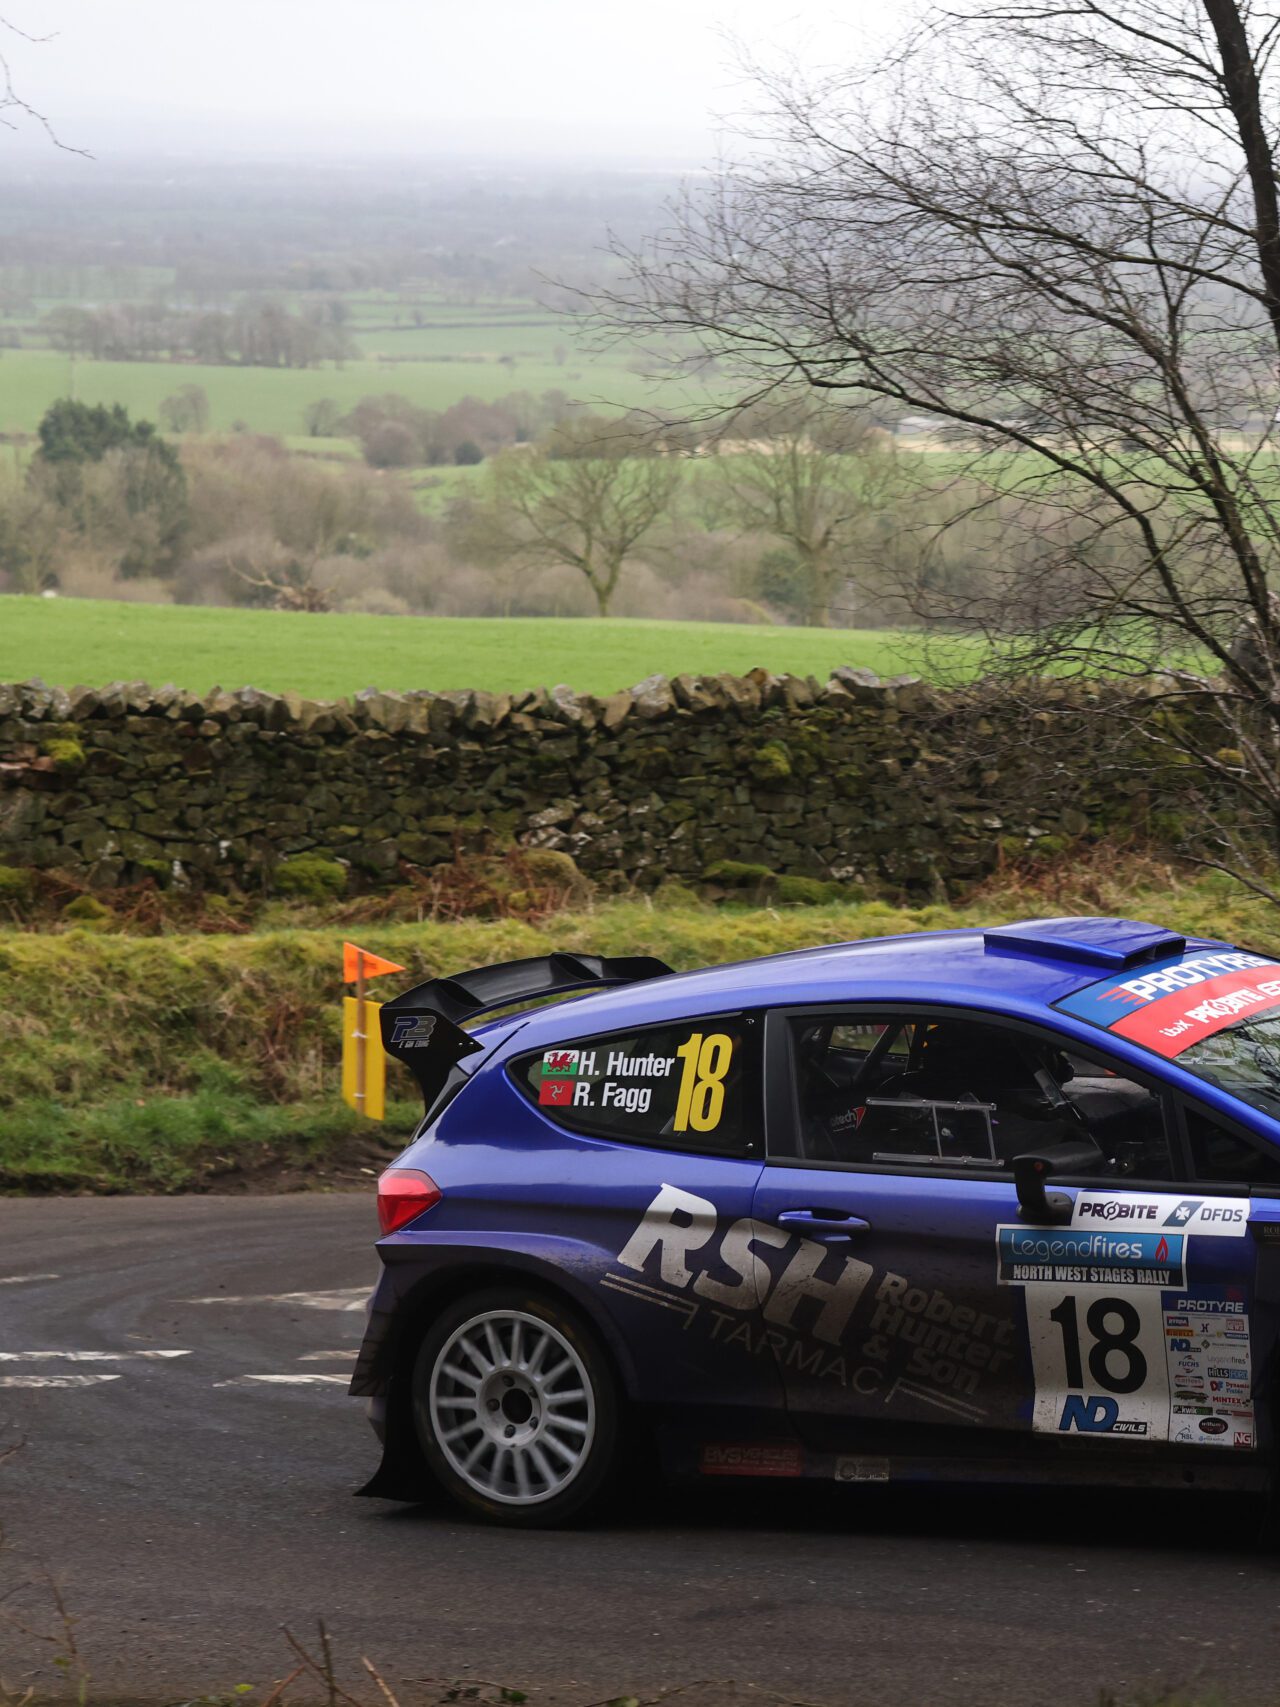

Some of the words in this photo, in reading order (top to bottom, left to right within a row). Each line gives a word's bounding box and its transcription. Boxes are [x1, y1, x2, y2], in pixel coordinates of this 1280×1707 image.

[1118, 952, 1269, 1001] PROTYRE
[390, 1015, 437, 1043] PB
[578, 1052, 600, 1077] H.
[606, 1052, 675, 1078] Hunter
[573, 1082, 595, 1107] R.
[601, 1082, 652, 1114] Fagg
[673, 1033, 733, 1133] 18
[1078, 1200, 1159, 1221] PROBITE
[1200, 1207, 1244, 1223] DFDS
[617, 1183, 874, 1347] RSH
[1010, 1232, 1143, 1263] Legendfires
[1013, 1264, 1053, 1280] NORTH
[1055, 1266, 1088, 1282] WEST
[1090, 1267, 1135, 1284] STAGES
[1137, 1269, 1170, 1285] RALLY
[874, 1271, 1016, 1345] Robert
[1177, 1299, 1245, 1313] PROTYRE
[706, 1308, 884, 1394] TARMAC
[869, 1301, 1016, 1375] Hunter
[1050, 1295, 1148, 1394] 18
[862, 1335, 889, 1361] &
[906, 1346, 981, 1394] Son
[1058, 1394, 1119, 1431] ND
[1113, 1422, 1146, 1433] CIVILS
[1234, 1432, 1251, 1444] NG
